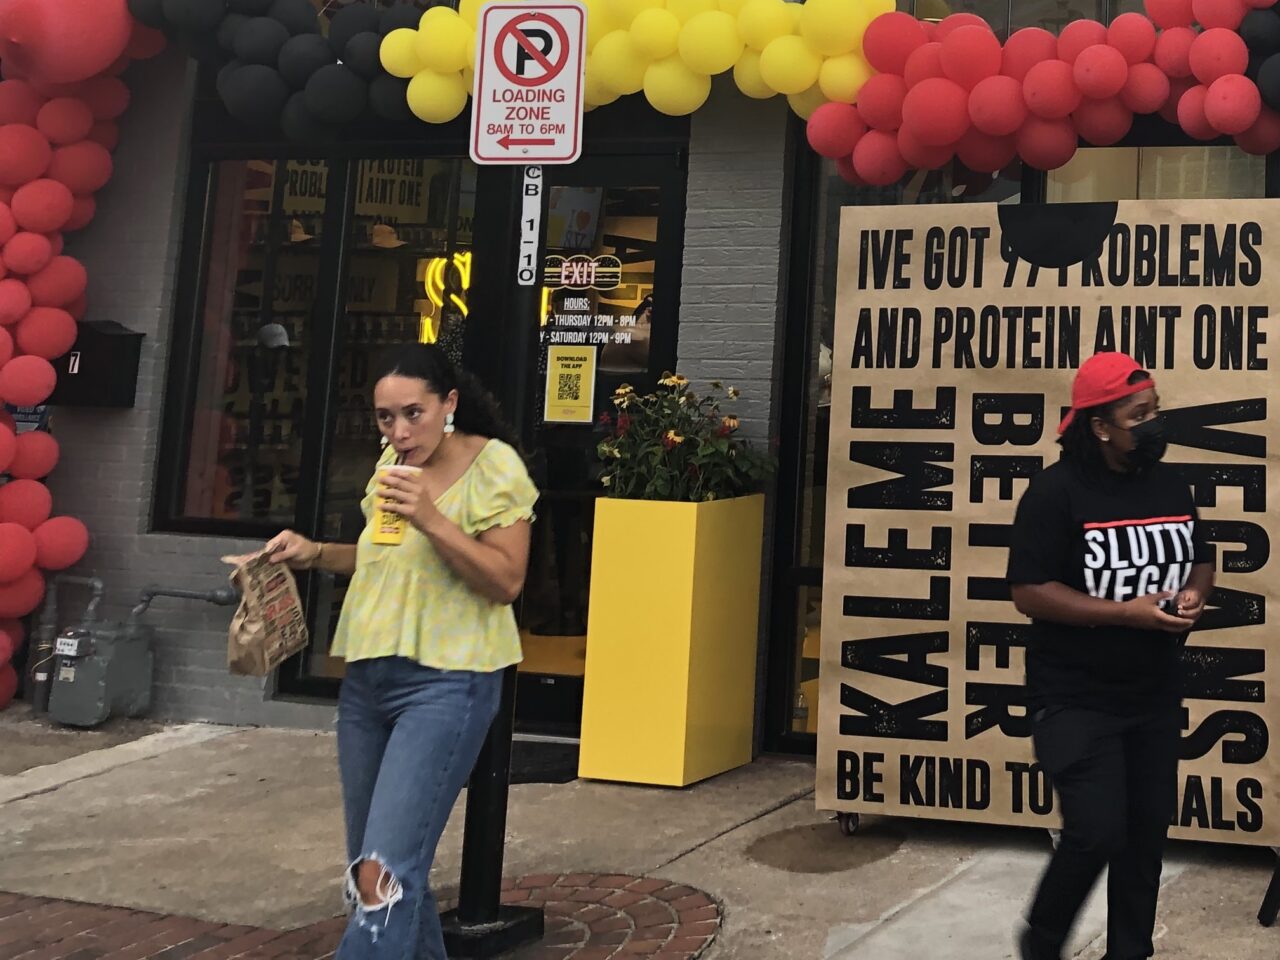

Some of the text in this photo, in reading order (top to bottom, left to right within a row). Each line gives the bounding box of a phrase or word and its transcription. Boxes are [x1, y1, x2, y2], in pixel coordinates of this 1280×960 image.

[492, 88, 566, 104] LOADING
[505, 106, 551, 121] ZONE
[486, 123, 566, 136] 8AM TO 6PM
[857, 227, 914, 291] IVE
[923, 225, 990, 290] GOT
[560, 261, 600, 284] EXIT
[563, 297, 591, 311] HOURS:
[554, 315, 592, 327] THURSDAY
[593, 315, 614, 327] 12PM
[619, 316, 637, 327] 8PM
[550, 331, 587, 344] SATURDAY
[589, 332, 609, 344] 12PM
[615, 332, 632, 344] 9PM
[851, 303, 1269, 371] AND PROTEIN AINT ONE
[1083, 520, 1195, 569] SLUTTY
[1083, 562, 1193, 603] VEGA
[836, 749, 885, 803] BE
[899, 754, 991, 812] KIND
[1004, 761, 1055, 816] TO
